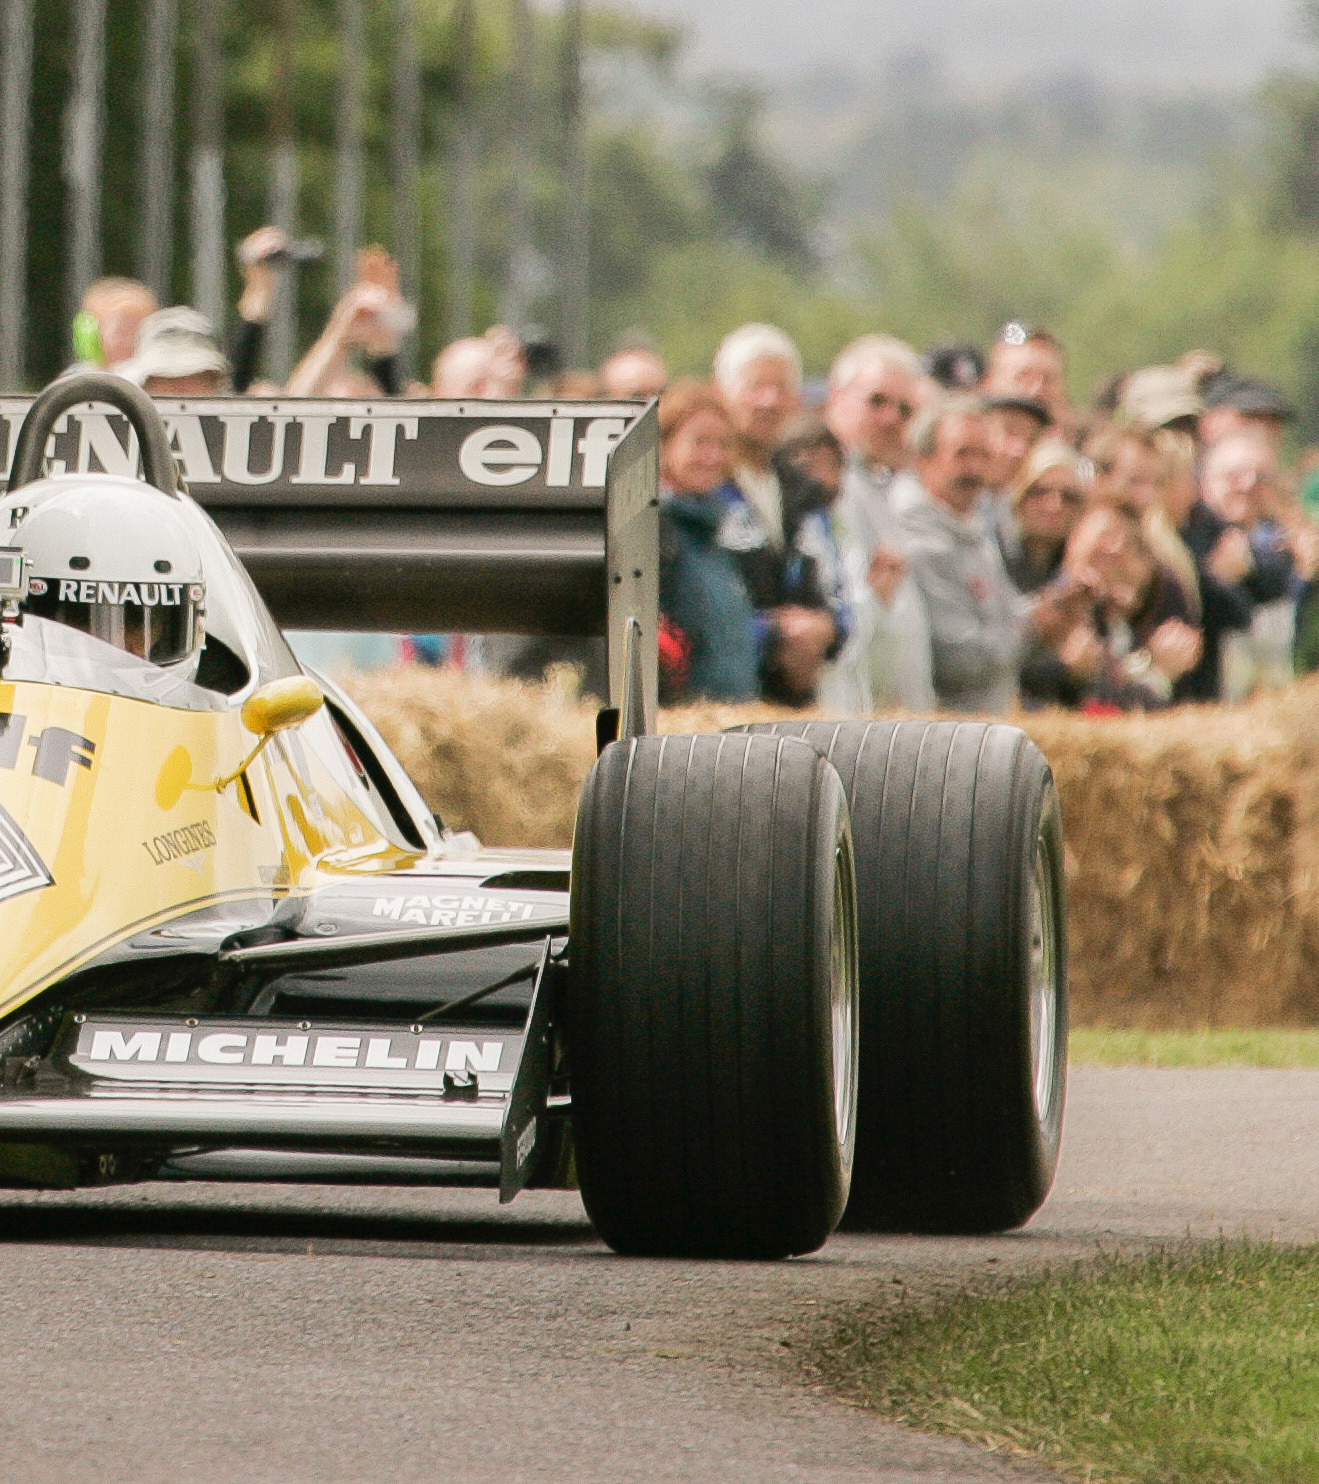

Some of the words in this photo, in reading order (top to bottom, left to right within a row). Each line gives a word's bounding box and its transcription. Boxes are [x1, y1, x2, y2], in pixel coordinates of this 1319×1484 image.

[459, 418, 625, 487] elf
[58, 579, 183, 606] RENAULT
[142, 819, 217, 866] LONGINES
[373, 895, 534, 915] MAGNETI
[373, 904, 534, 926] MARELLI
[89, 1030, 504, 1072] MICHELIN
